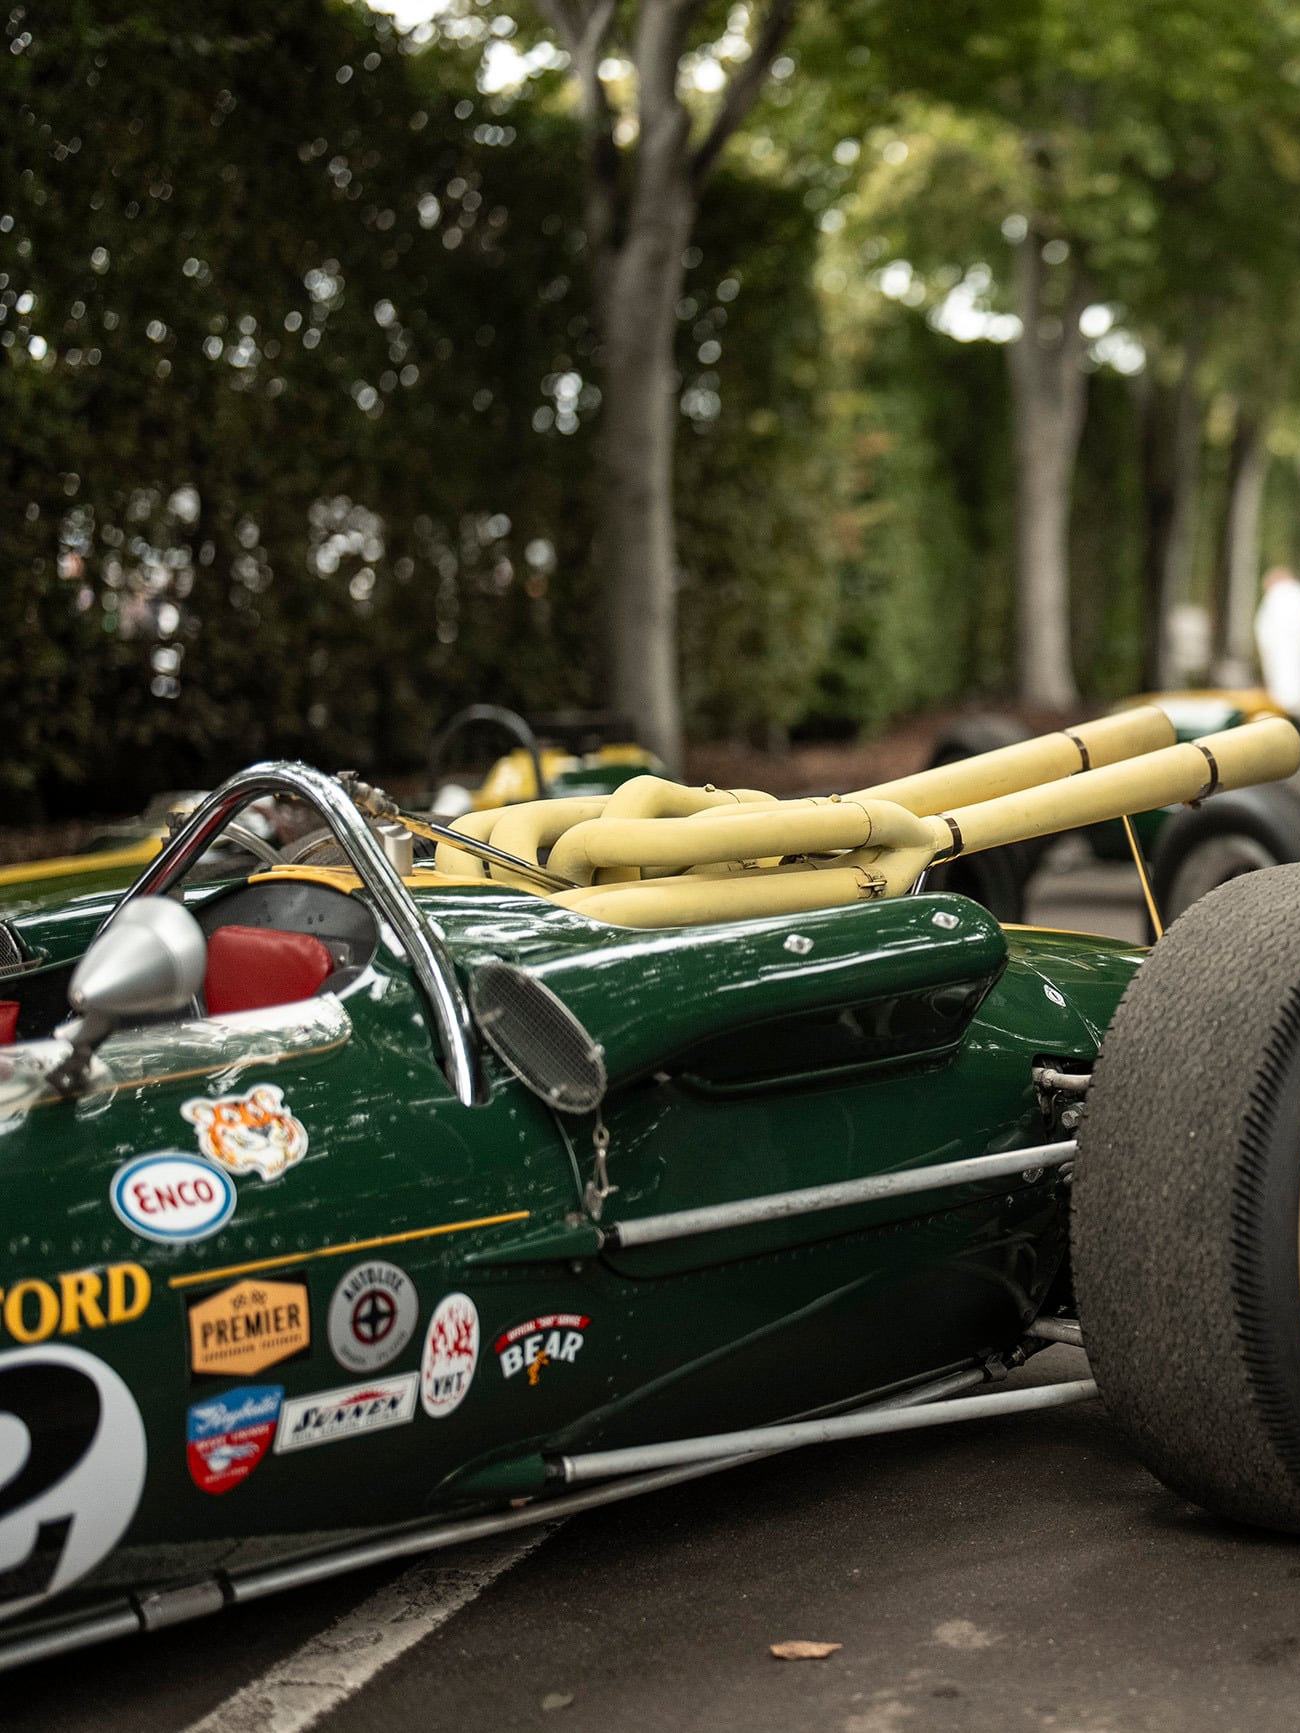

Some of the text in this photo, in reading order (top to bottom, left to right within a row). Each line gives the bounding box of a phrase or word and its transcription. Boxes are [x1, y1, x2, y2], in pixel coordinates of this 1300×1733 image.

[133, 1177, 214, 1215] ENCO
[0, 1260, 152, 1344] ORD
[200, 1302, 301, 1350] PREMIER
[500, 1329, 585, 1379] BEAR
[434, 1370, 465, 1398] VHT
[292, 1394, 405, 1434] SUNNEN
